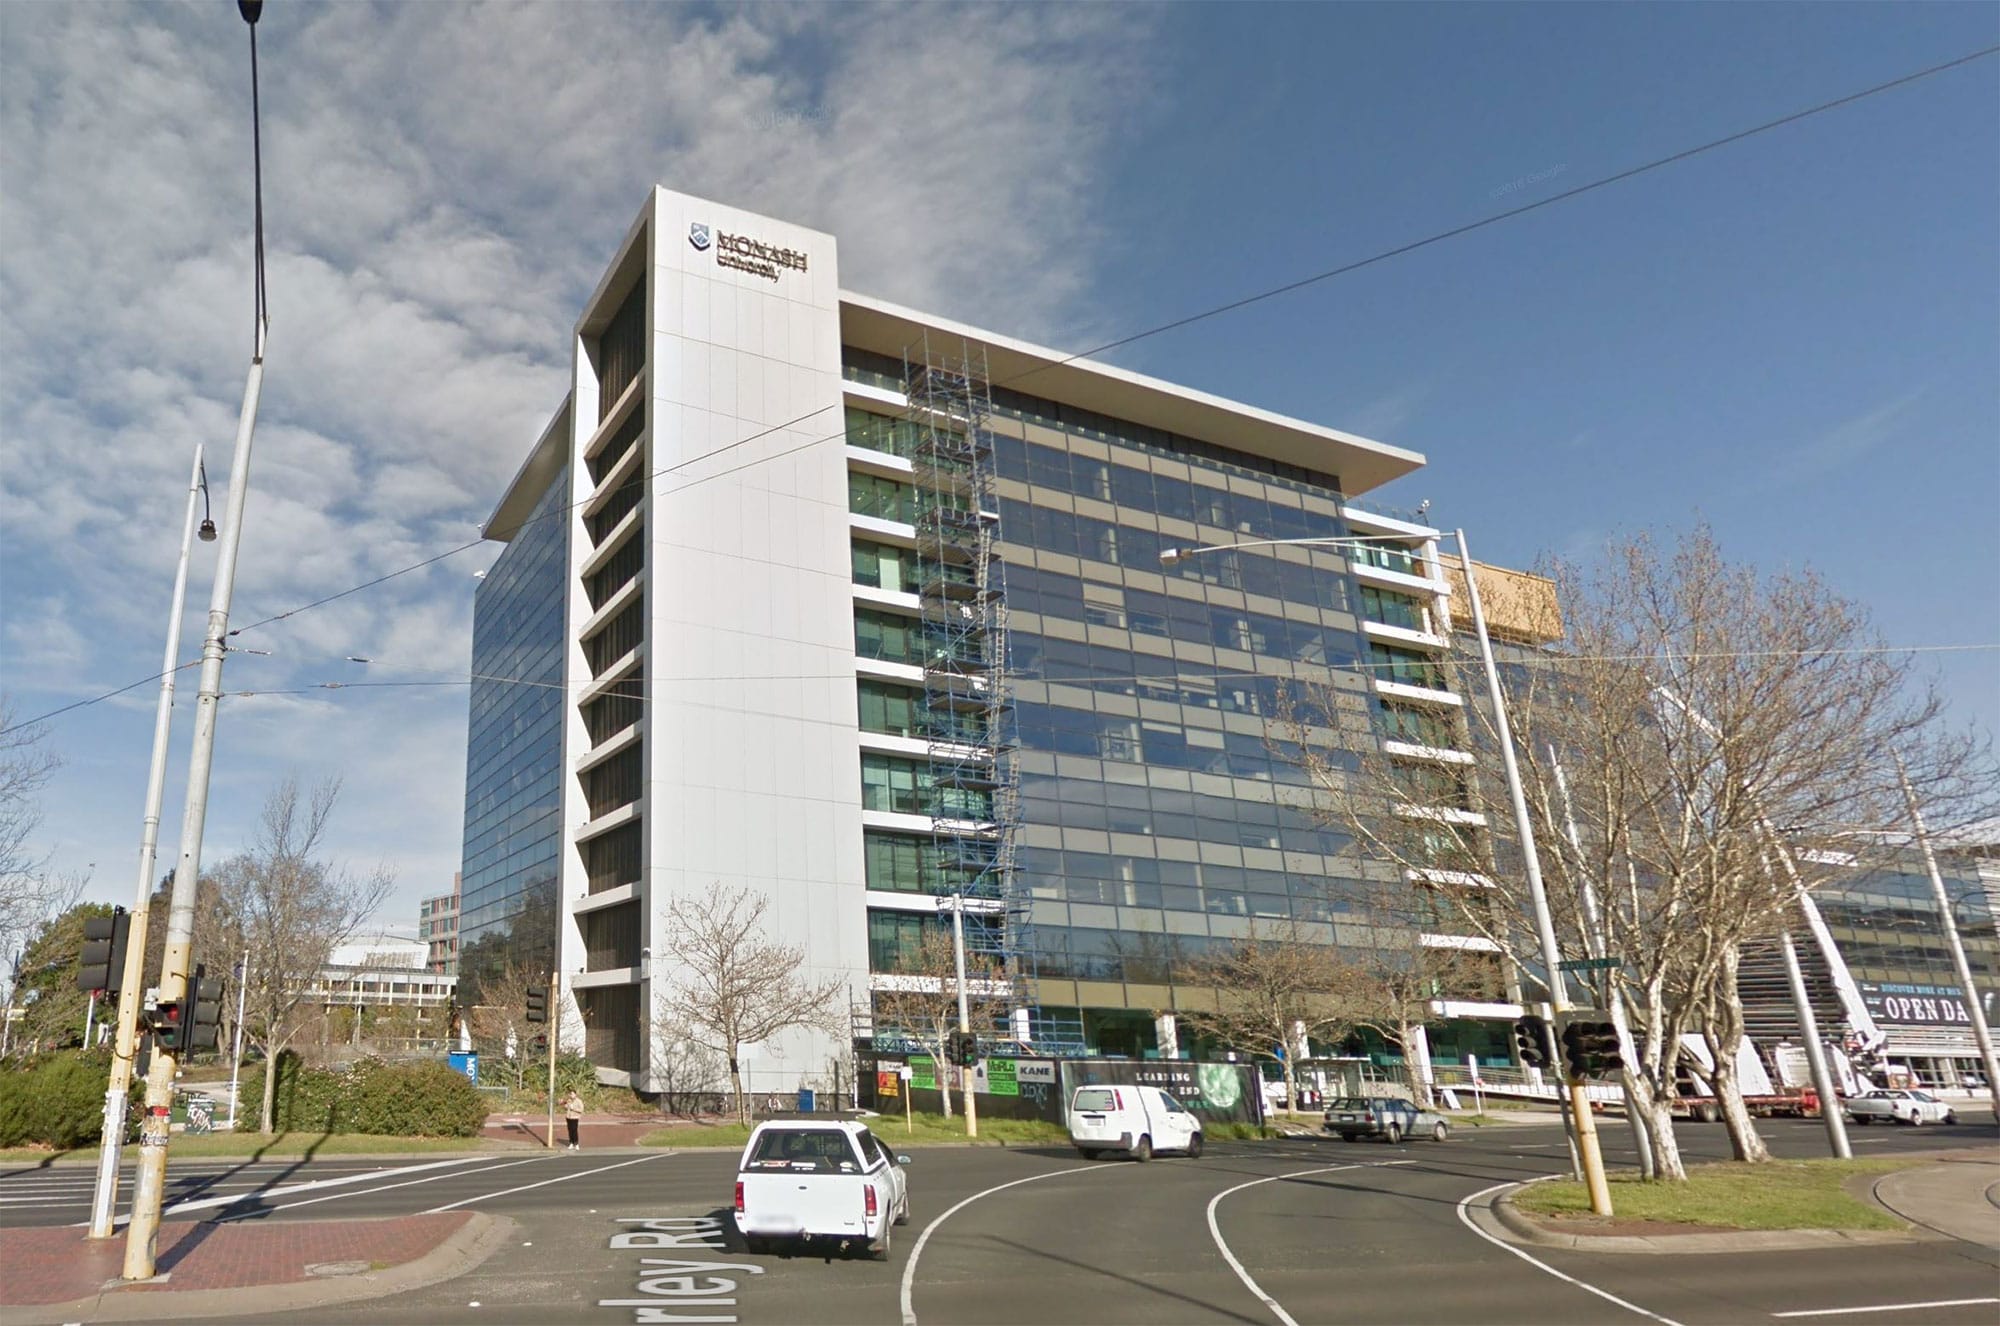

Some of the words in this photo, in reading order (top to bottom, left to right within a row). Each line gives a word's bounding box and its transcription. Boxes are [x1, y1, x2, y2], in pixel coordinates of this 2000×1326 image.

[717, 230, 807, 273] MONASH
[717, 249, 781, 283] University
[1885, 997, 1939, 1020] OPEN
[1939, 999, 1970, 1021] DA
[1020, 1066, 1051, 1076] KANE
